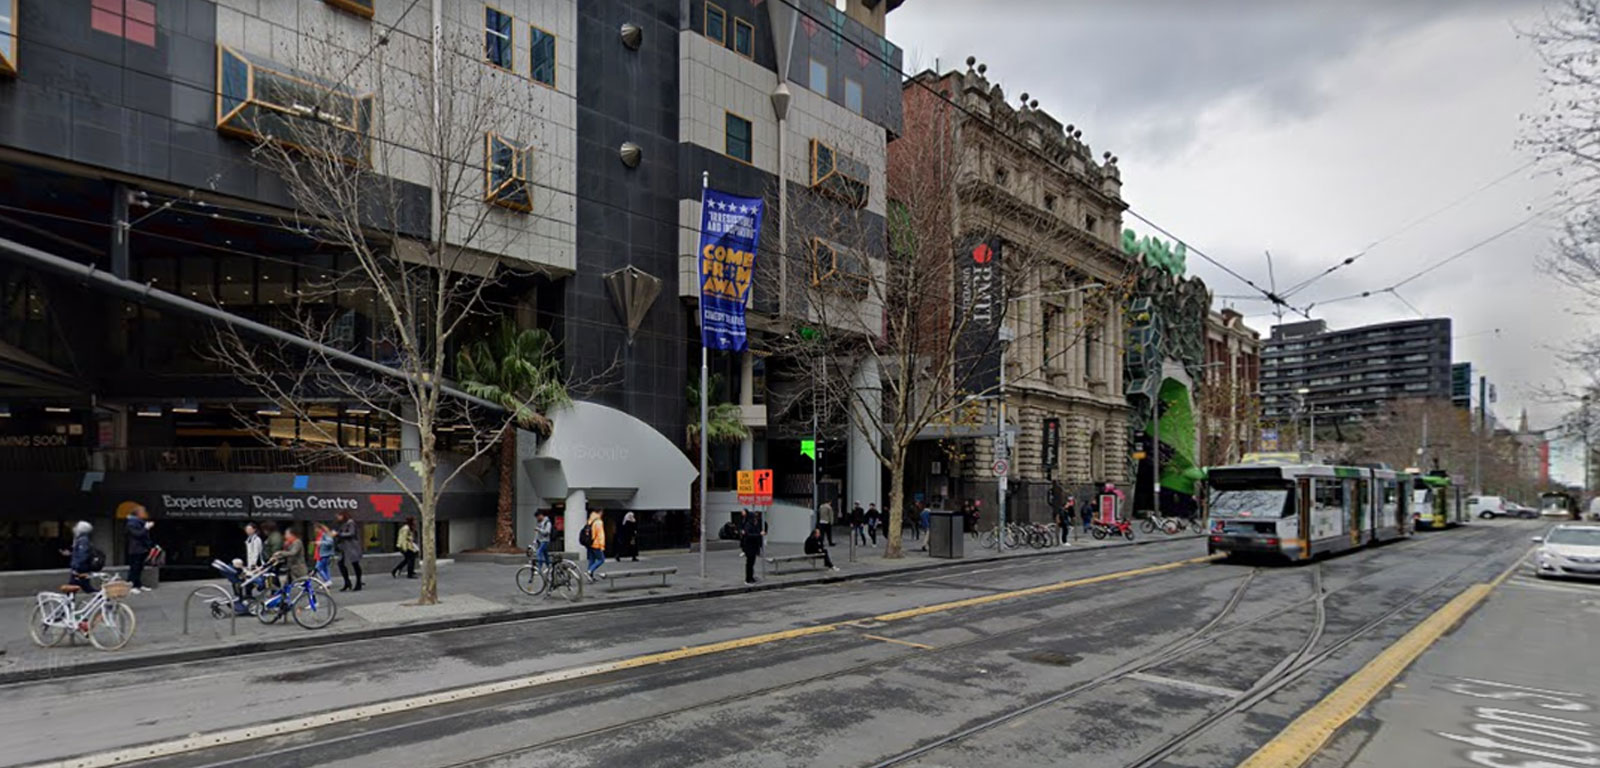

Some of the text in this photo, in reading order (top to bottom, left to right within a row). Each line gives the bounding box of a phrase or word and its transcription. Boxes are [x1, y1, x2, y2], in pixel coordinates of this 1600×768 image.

[703, 244, 754, 267] COME
[703, 259, 752, 284] FROM
[703, 277, 750, 299] AWAY
[973, 266, 992, 325] RMIT
[32, 434, 67, 446] SOON
[162, 494, 359, 511] Experience Design Centre
